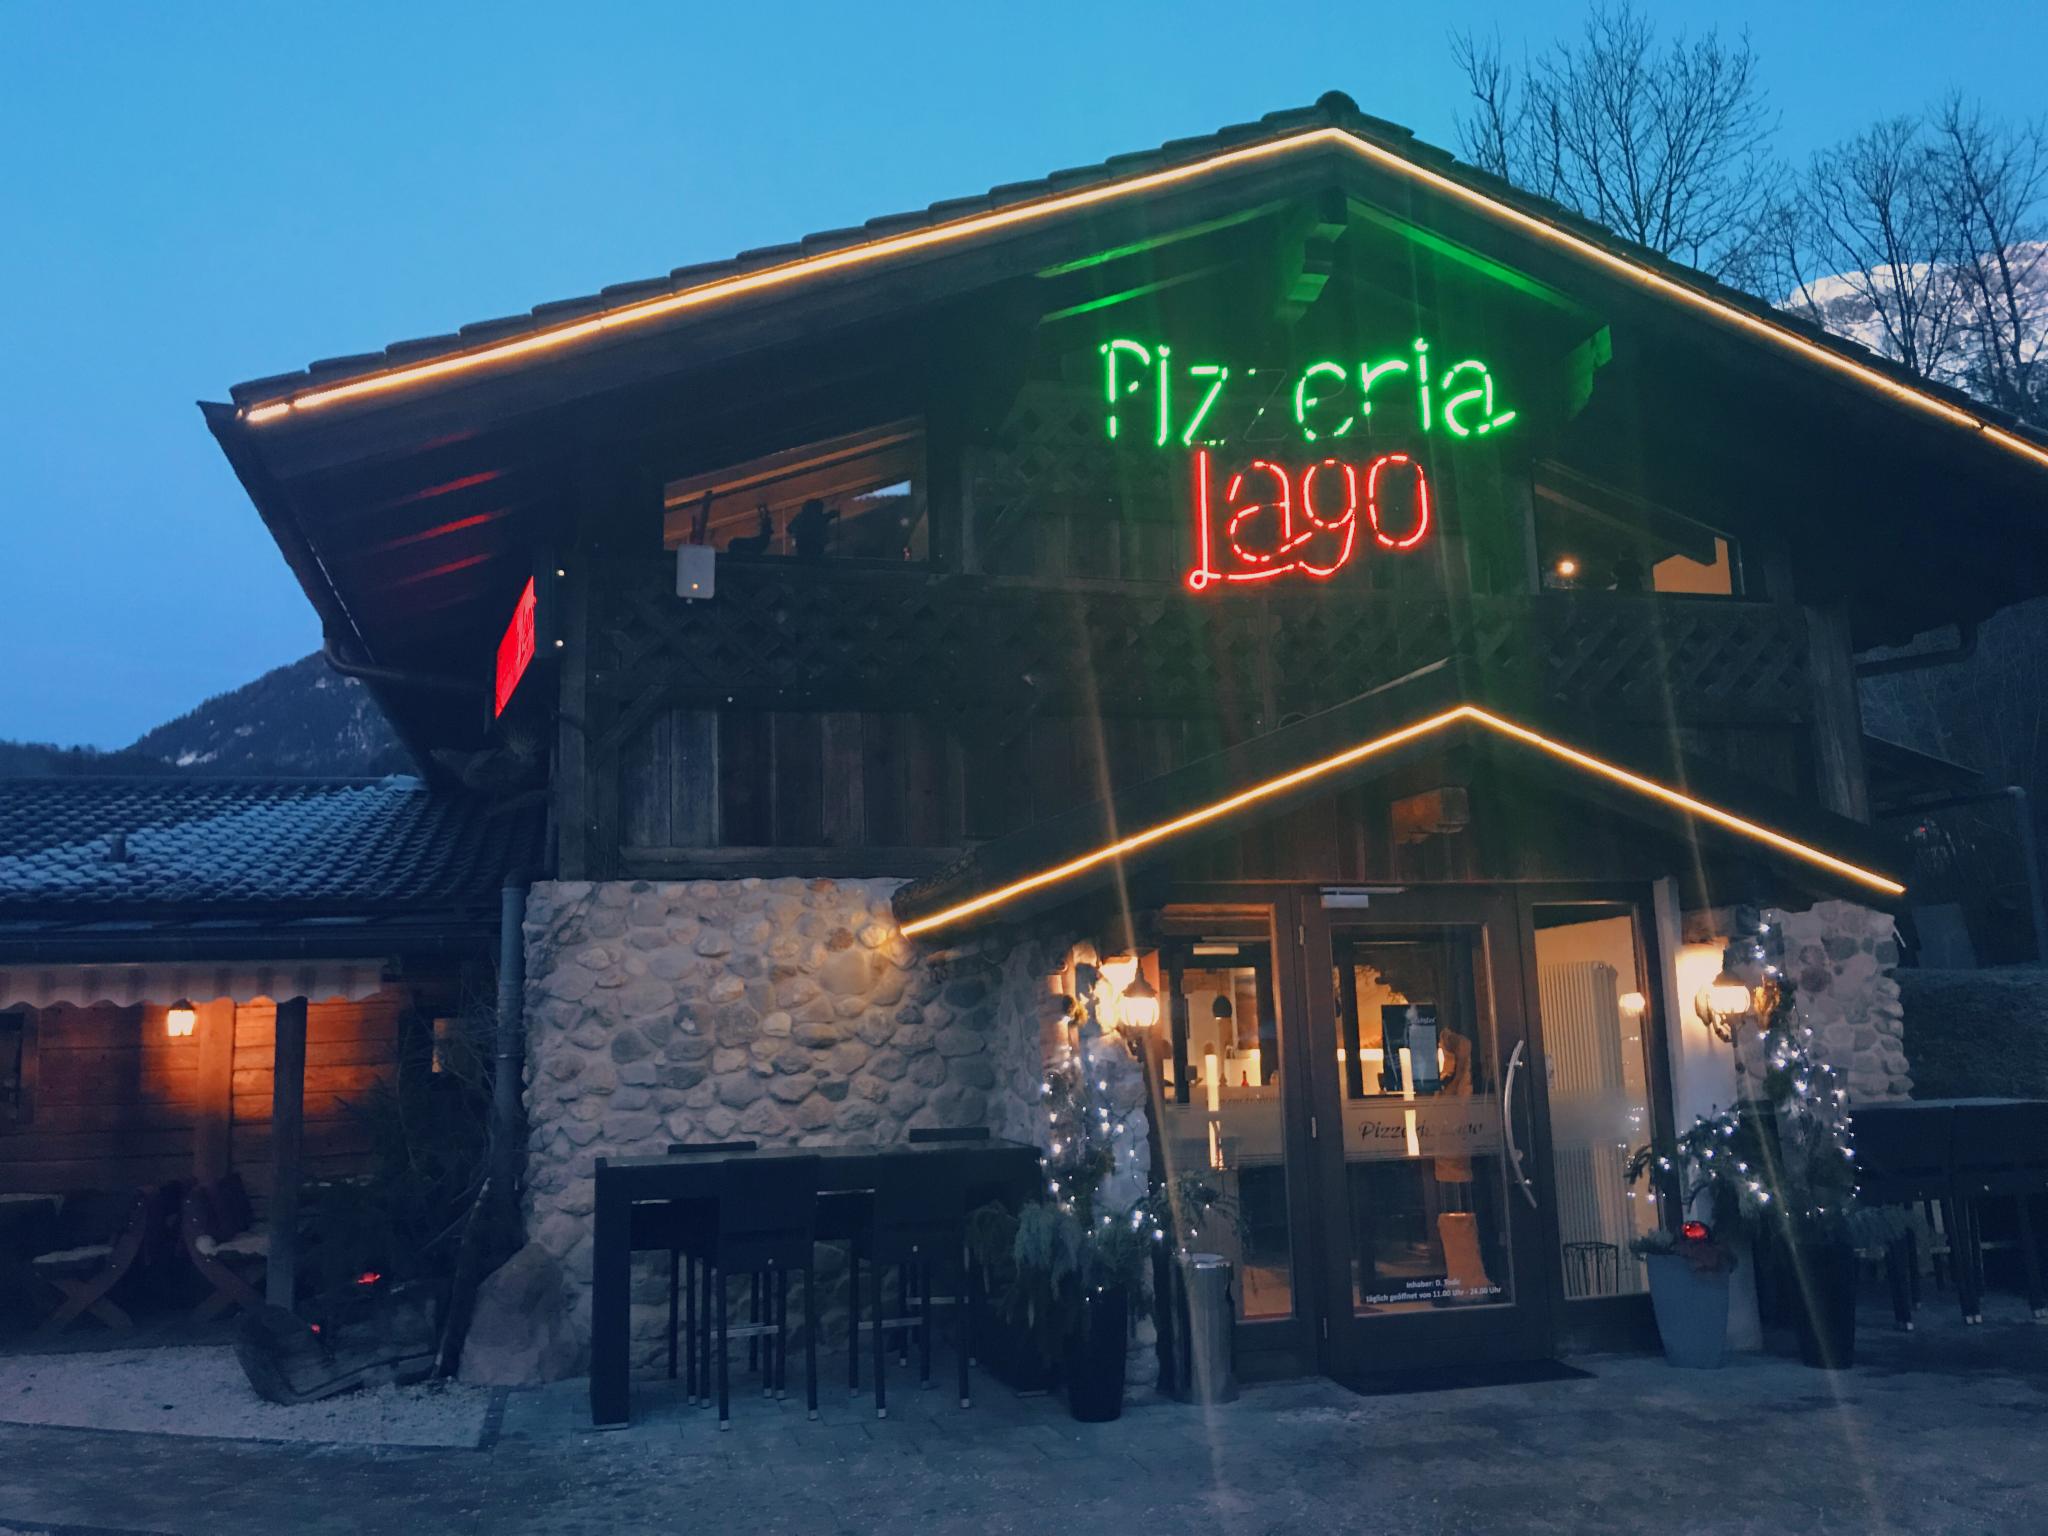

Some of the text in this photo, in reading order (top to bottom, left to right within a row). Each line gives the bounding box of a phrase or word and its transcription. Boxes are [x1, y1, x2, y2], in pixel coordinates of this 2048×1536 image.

[1100, 337, 1516, 447] Pizzeria
[1189, 450, 1428, 590] Lago
[1433, 1290, 1451, 1298] 11.00
[1489, 1286, 1502, 1294] Uhr
